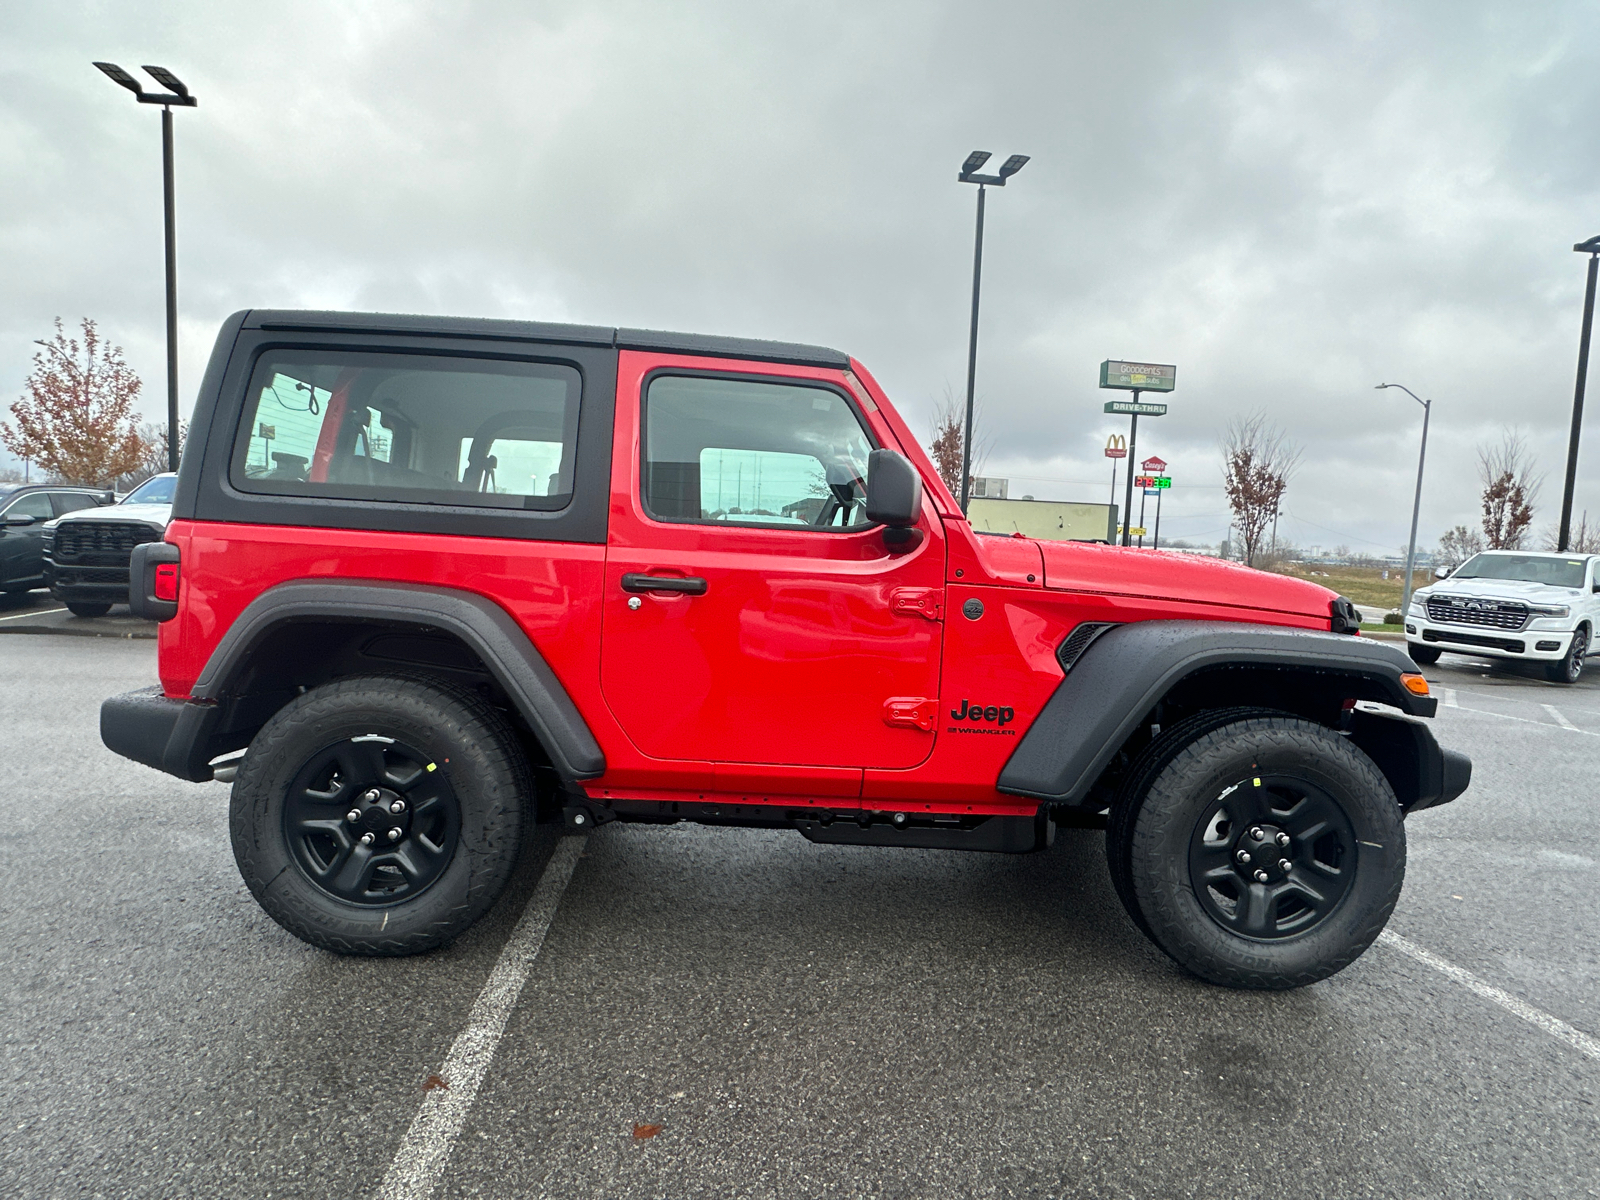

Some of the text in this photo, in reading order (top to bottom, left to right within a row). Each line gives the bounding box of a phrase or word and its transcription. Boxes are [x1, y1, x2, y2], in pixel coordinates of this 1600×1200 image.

[1113, 402, 1165, 412] DRIVE-THRU
[1144, 461, 1165, 470] Casey's
[1451, 601, 1498, 611] RAM
[950, 699, 1014, 726] Jeep
[958, 727, 1016, 736] WRANGLER
